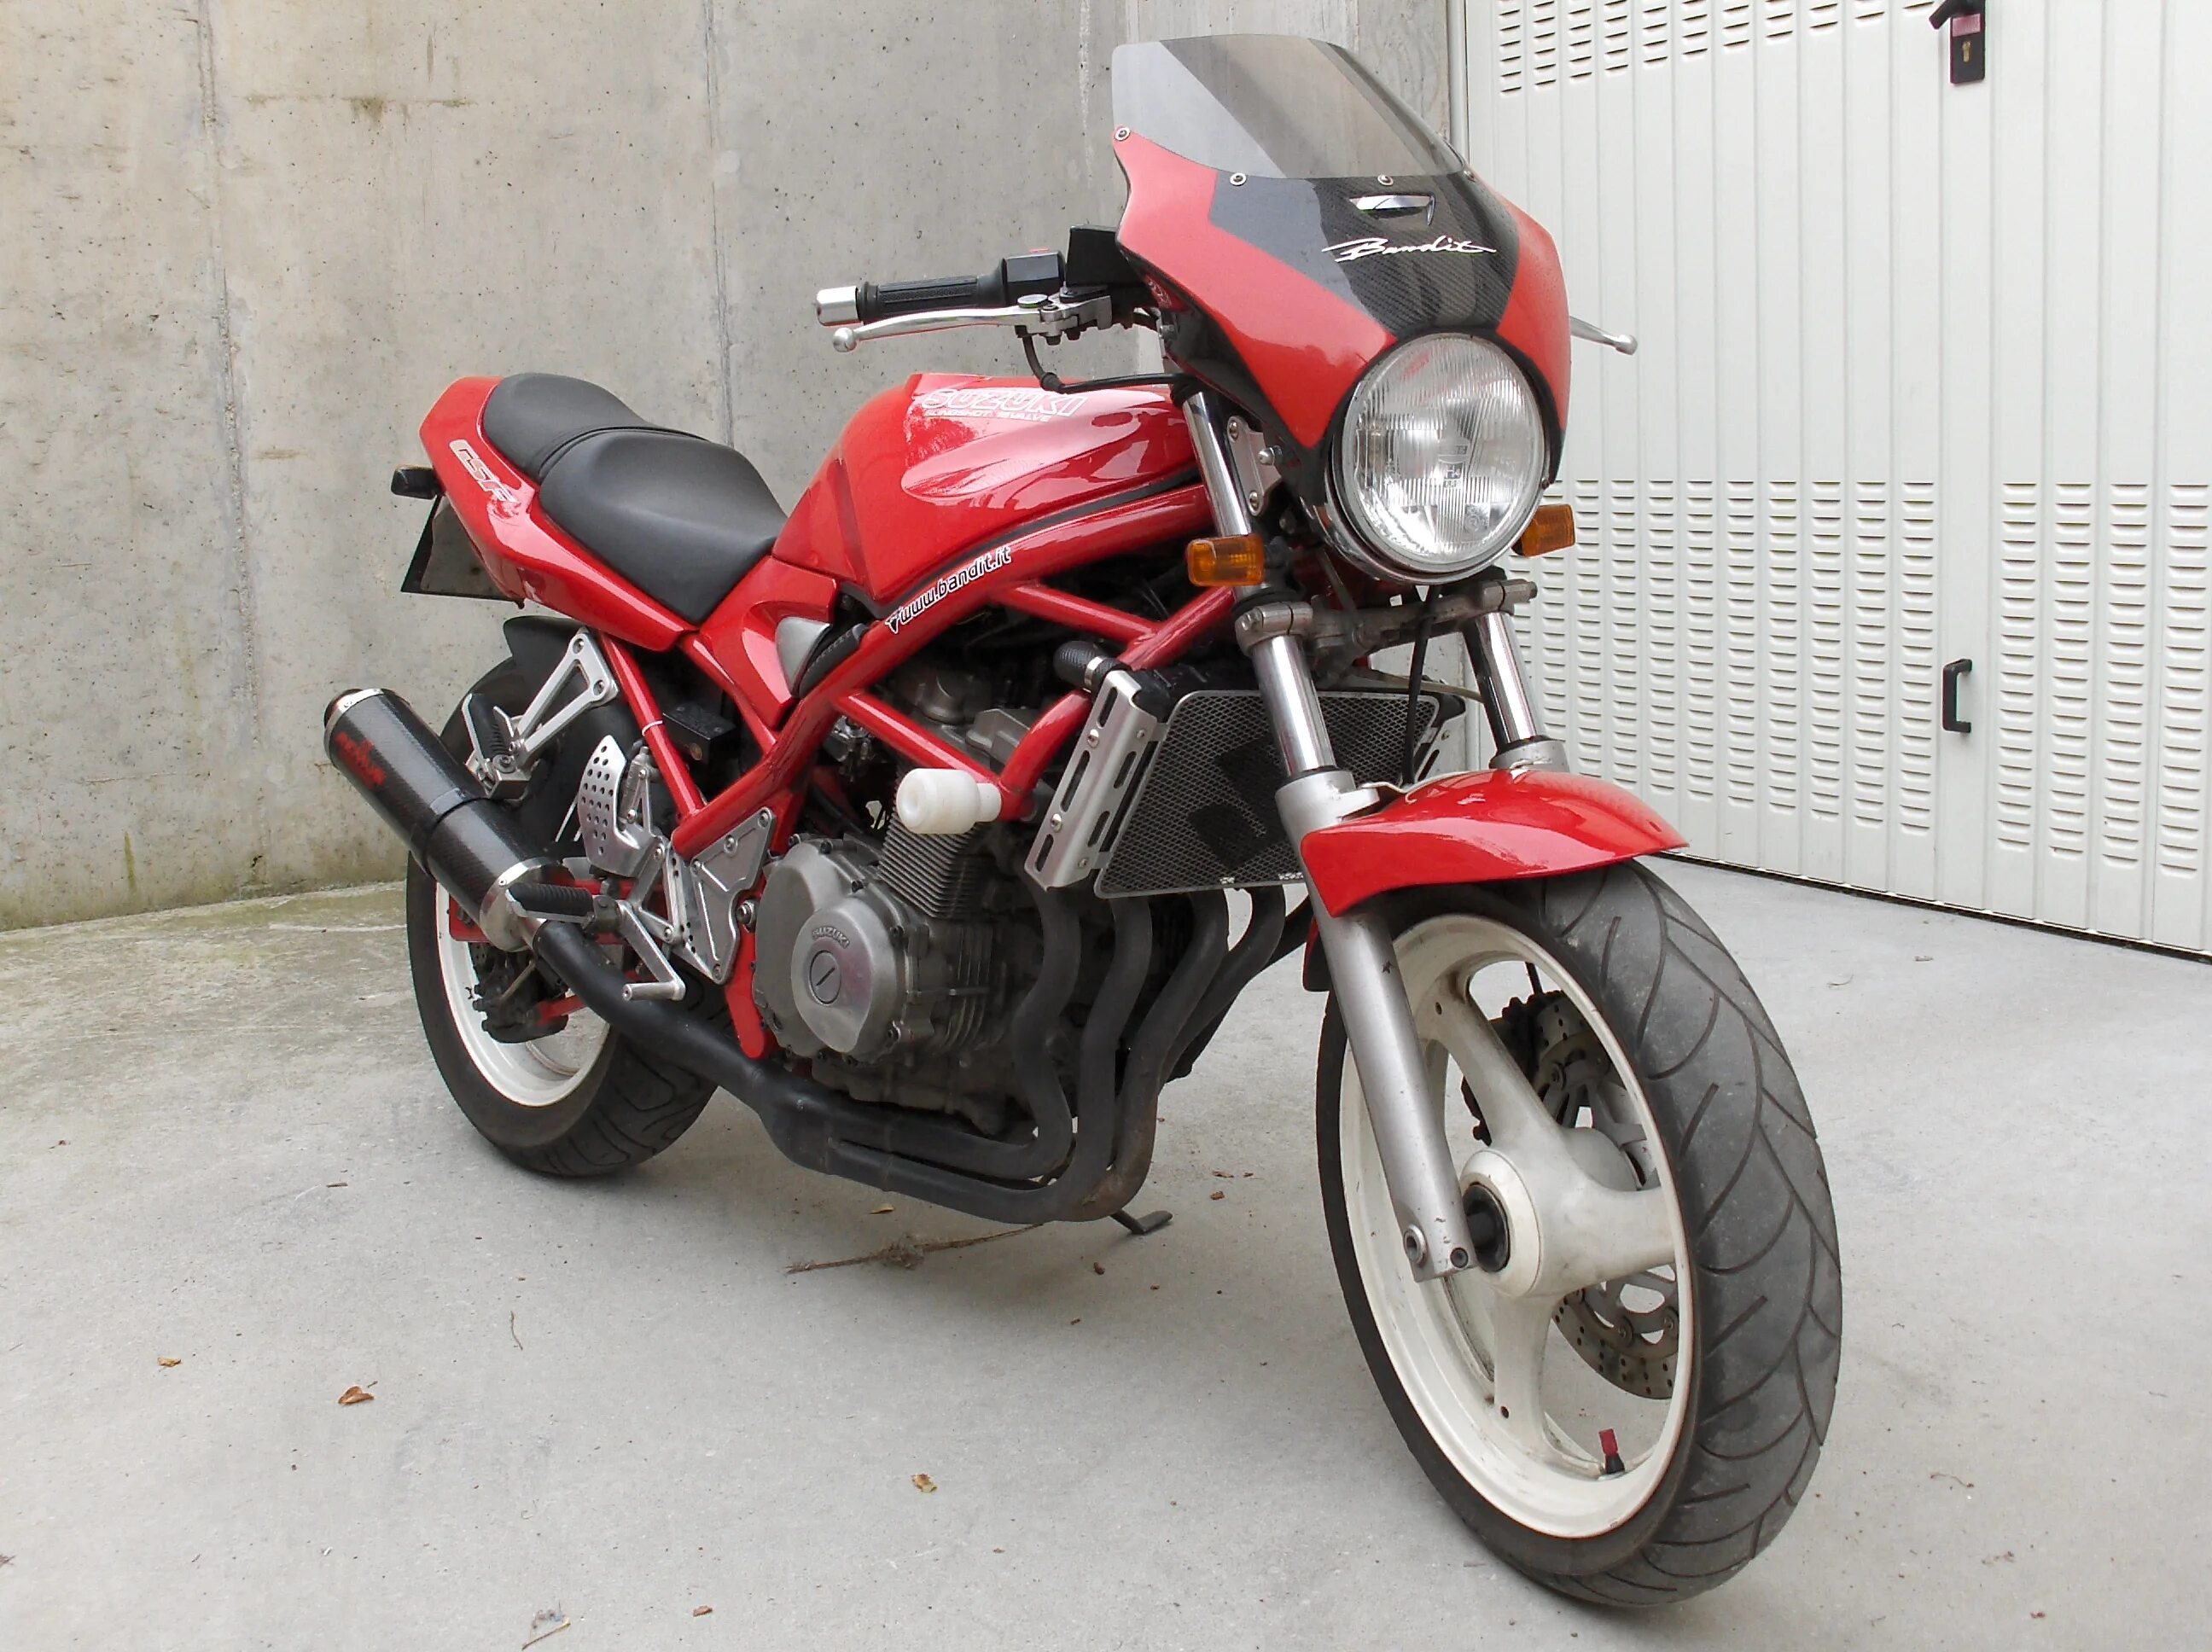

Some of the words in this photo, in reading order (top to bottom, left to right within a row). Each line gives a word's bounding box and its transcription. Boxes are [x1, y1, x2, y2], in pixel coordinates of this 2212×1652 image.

[1321, 236, 1497, 263] Bandit
[922, 389, 1087, 416] SUZUKI
[450, 439, 517, 503] GSF
[896, 544, 1011, 625] www.bandit.it
[812, 926, 850, 949] SUZUKI
